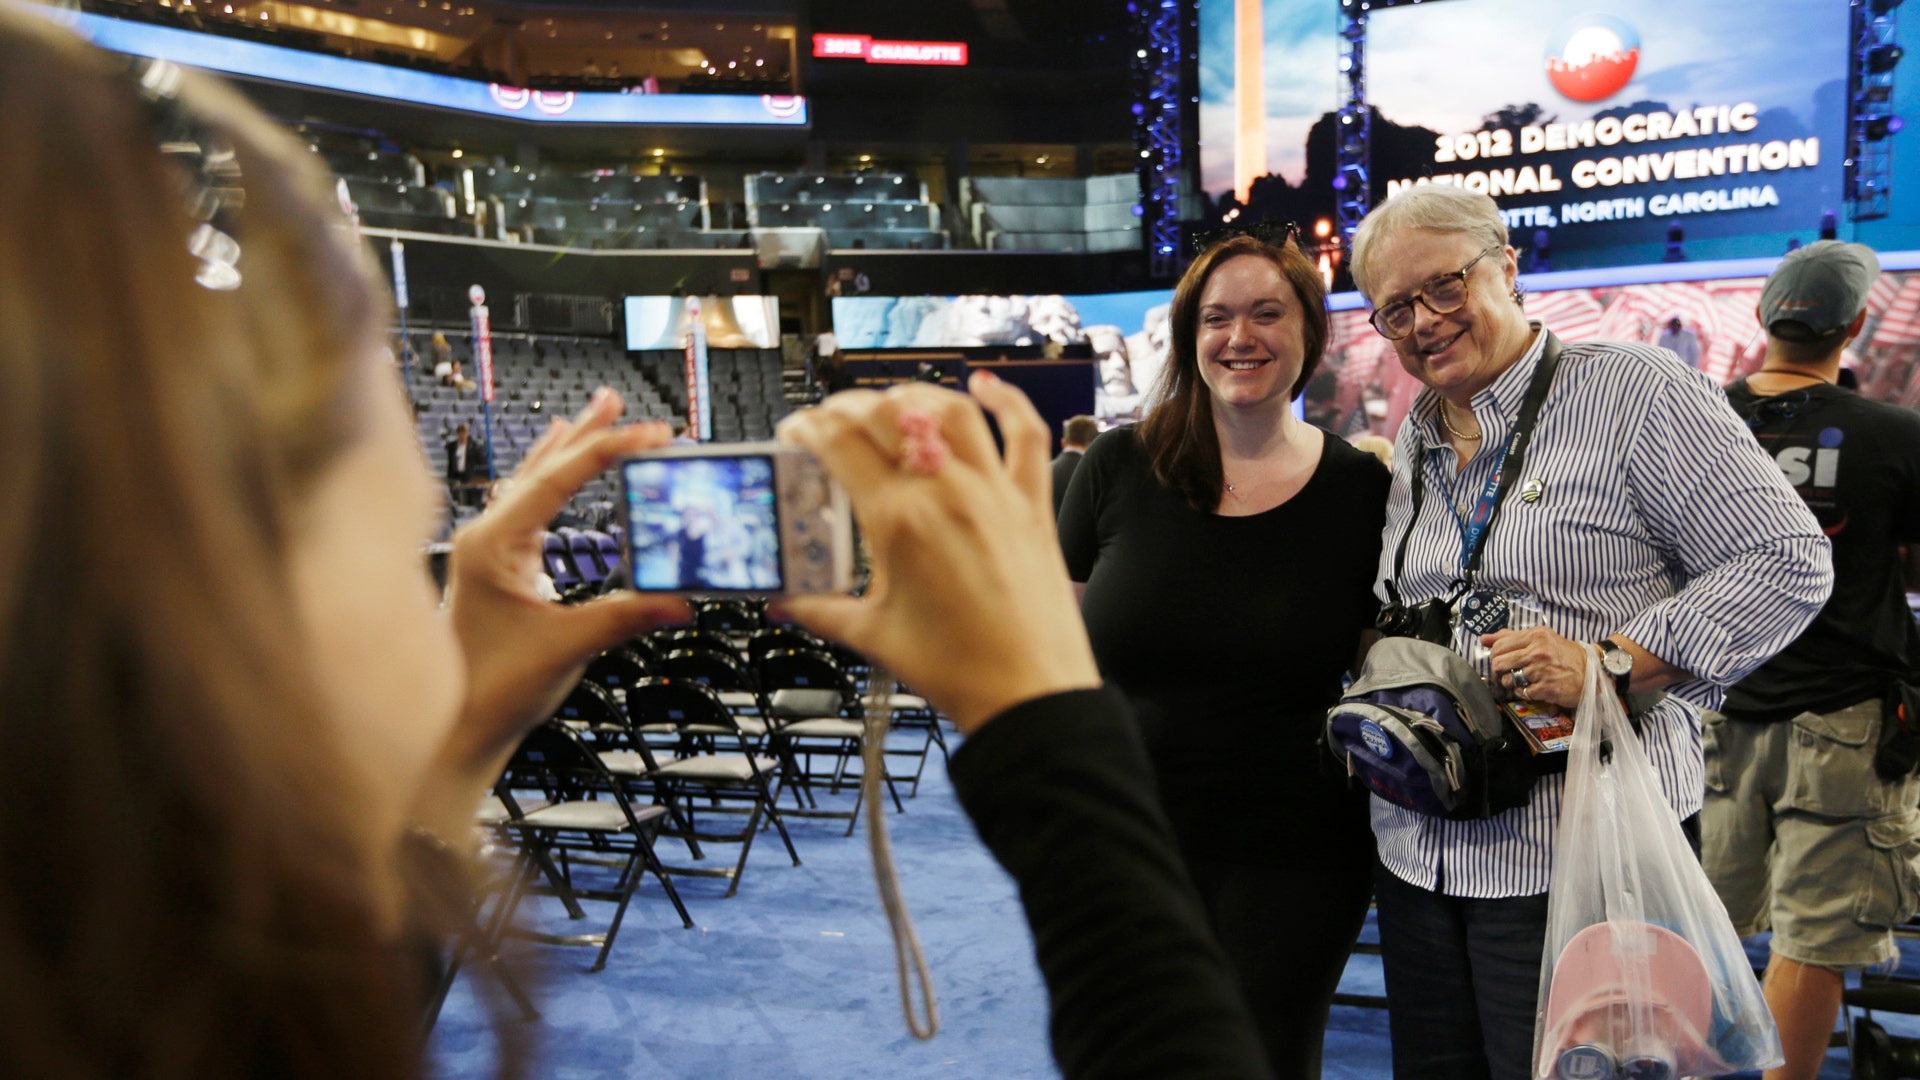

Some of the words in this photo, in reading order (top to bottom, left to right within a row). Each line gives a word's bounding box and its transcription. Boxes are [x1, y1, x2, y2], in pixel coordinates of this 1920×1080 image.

[824, 39, 862, 54] 2012
[870, 44, 961, 61] CHARLOTTE
[1433, 128, 1513, 162] 2012
[1519, 101, 1759, 154] DEMOCRATIC
[1571, 137, 1819, 188] CONVENTION
[1561, 196, 1645, 224] NORTH
[1649, 184, 1779, 216] CAROLINA
[1464, 595, 1502, 627] OBAMA
[1474, 602, 1506, 633] BIDEN
